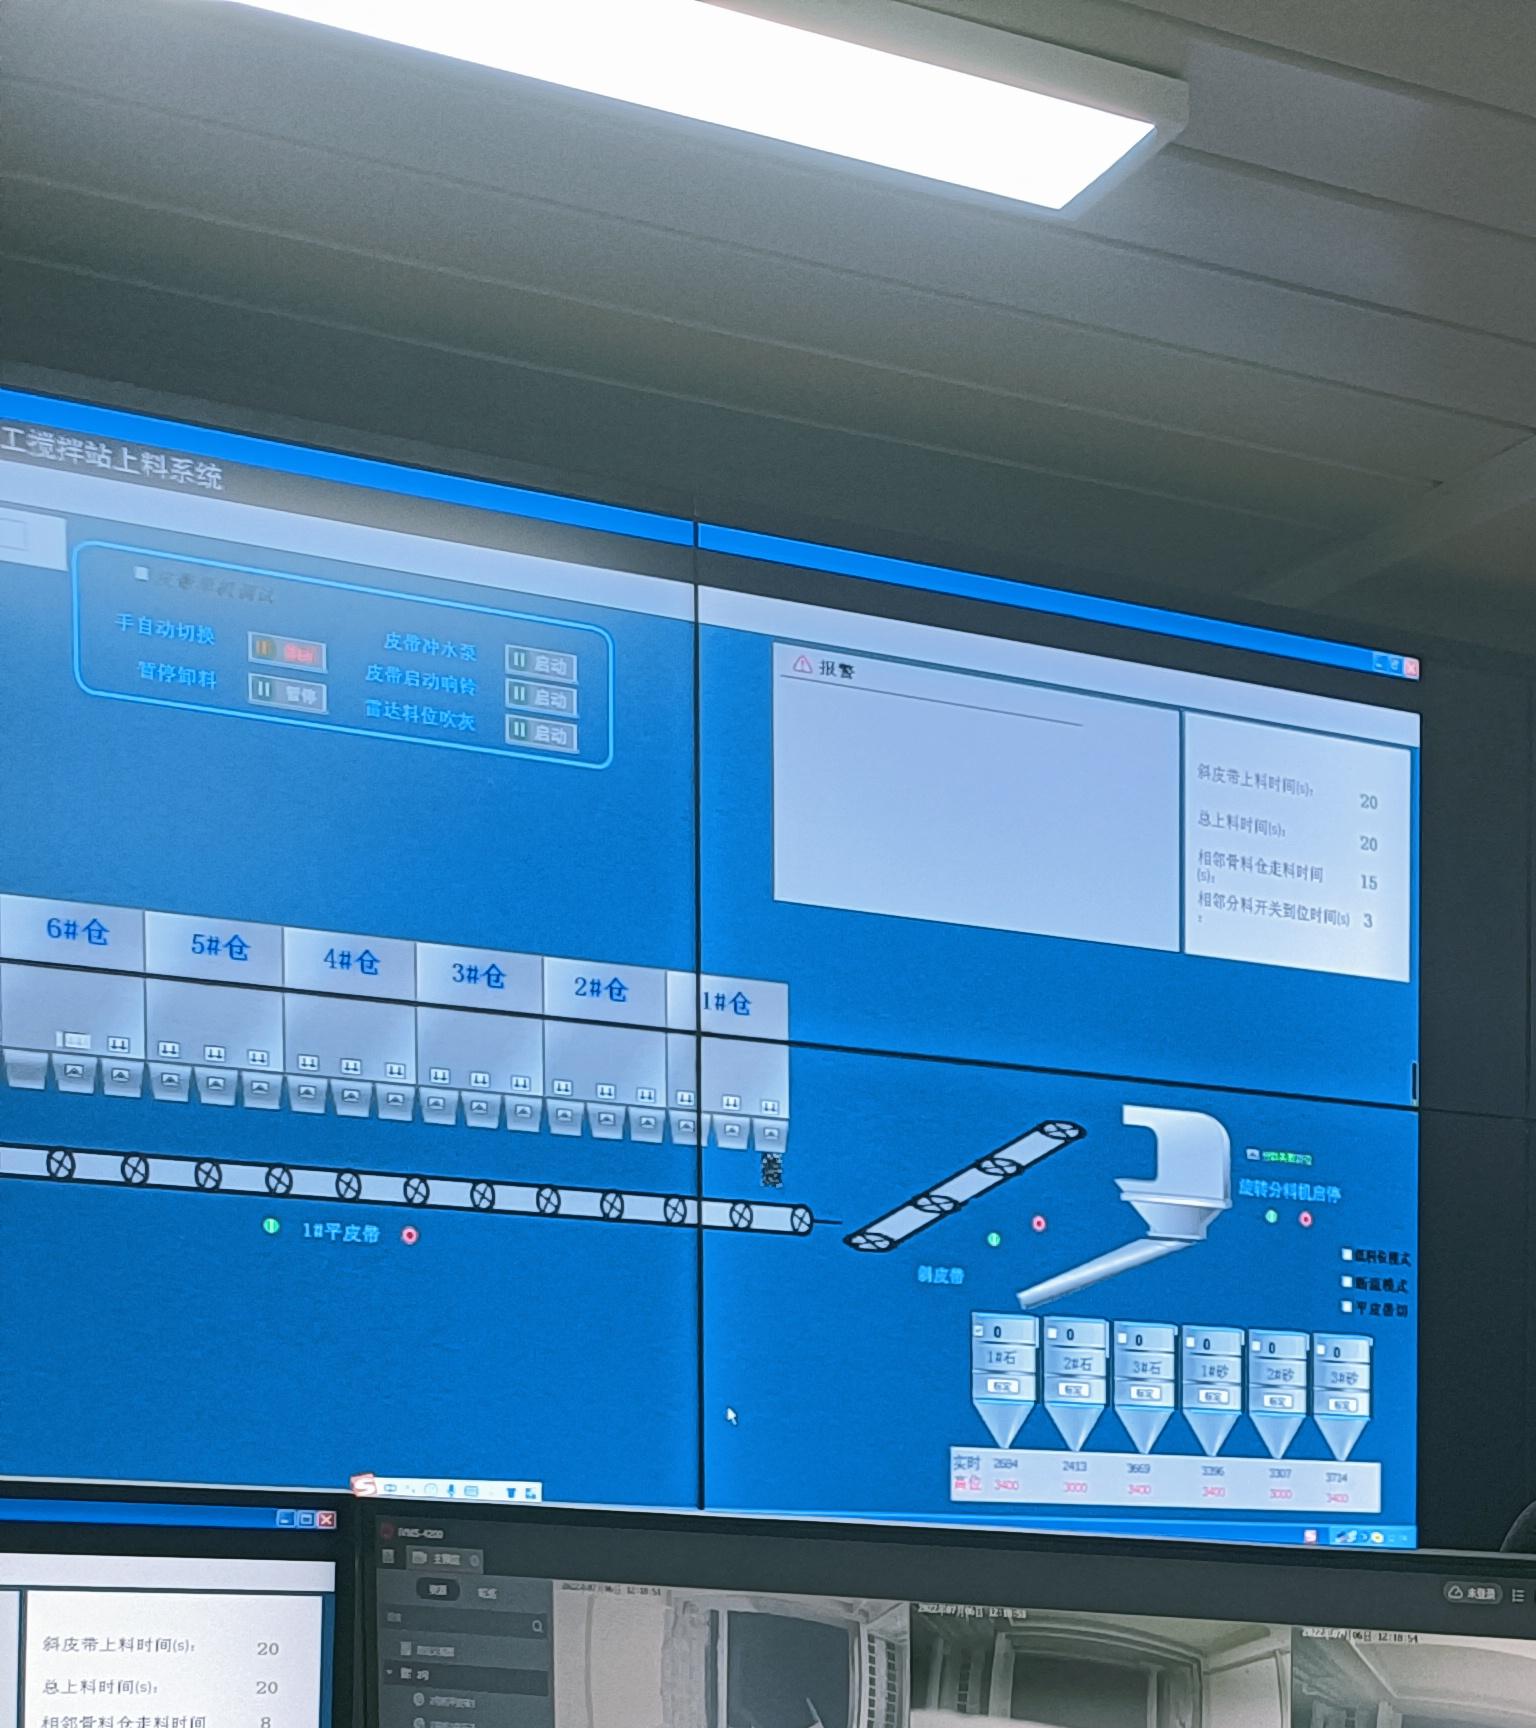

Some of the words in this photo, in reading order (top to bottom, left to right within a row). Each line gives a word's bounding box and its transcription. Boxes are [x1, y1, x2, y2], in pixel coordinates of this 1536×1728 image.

[115, 612, 217, 646] 手自动切换
[384, 631, 478, 662] 皮带冲水泵
[533, 654, 567, 676] 启动
[819, 658, 855, 679] 报警
[138, 661, 217, 691] 暂停卸料
[364, 663, 478, 697] 皮带启动响铃
[533, 690, 567, 711] 启动
[533, 725, 567, 746] 启动
[1360, 794, 1378, 809] 20
[1360, 836, 1378, 851] 20
[1361, 875, 1377, 890] 15
[1363, 913, 1373, 927] 3
[47, 917, 109, 946] 6#仓
[191, 933, 250, 962] 5#仓
[324, 949, 380, 976] 4#仓
[452, 962, 506, 990] 3#仓
[574, 975, 628, 1002] 2#仓
[702, 991, 751, 1017] 1#仓
[303, 1222, 381, 1243] 1#平皮带
[994, 1326, 1001, 1339] 0
[1067, 1328, 1074, 1341] 0
[1135, 1333, 1142, 1347] 0
[987, 1350, 1017, 1365] 1#石
[1064, 1356, 1093, 1372] 2#石
[1133, 1360, 1161, 1375] 3#石
[1202, 1364, 1229, 1379] 1#砂
[1267, 1367, 1294, 1383] 2#砂
[1331, 1371, 1358, 1386] 3#砂
[954, 1456, 980, 1471] 实时
[257, 1642, 279, 1656] 20
[256, 1682, 278, 1695] 20
[261, 1717, 271, 1728] 8
